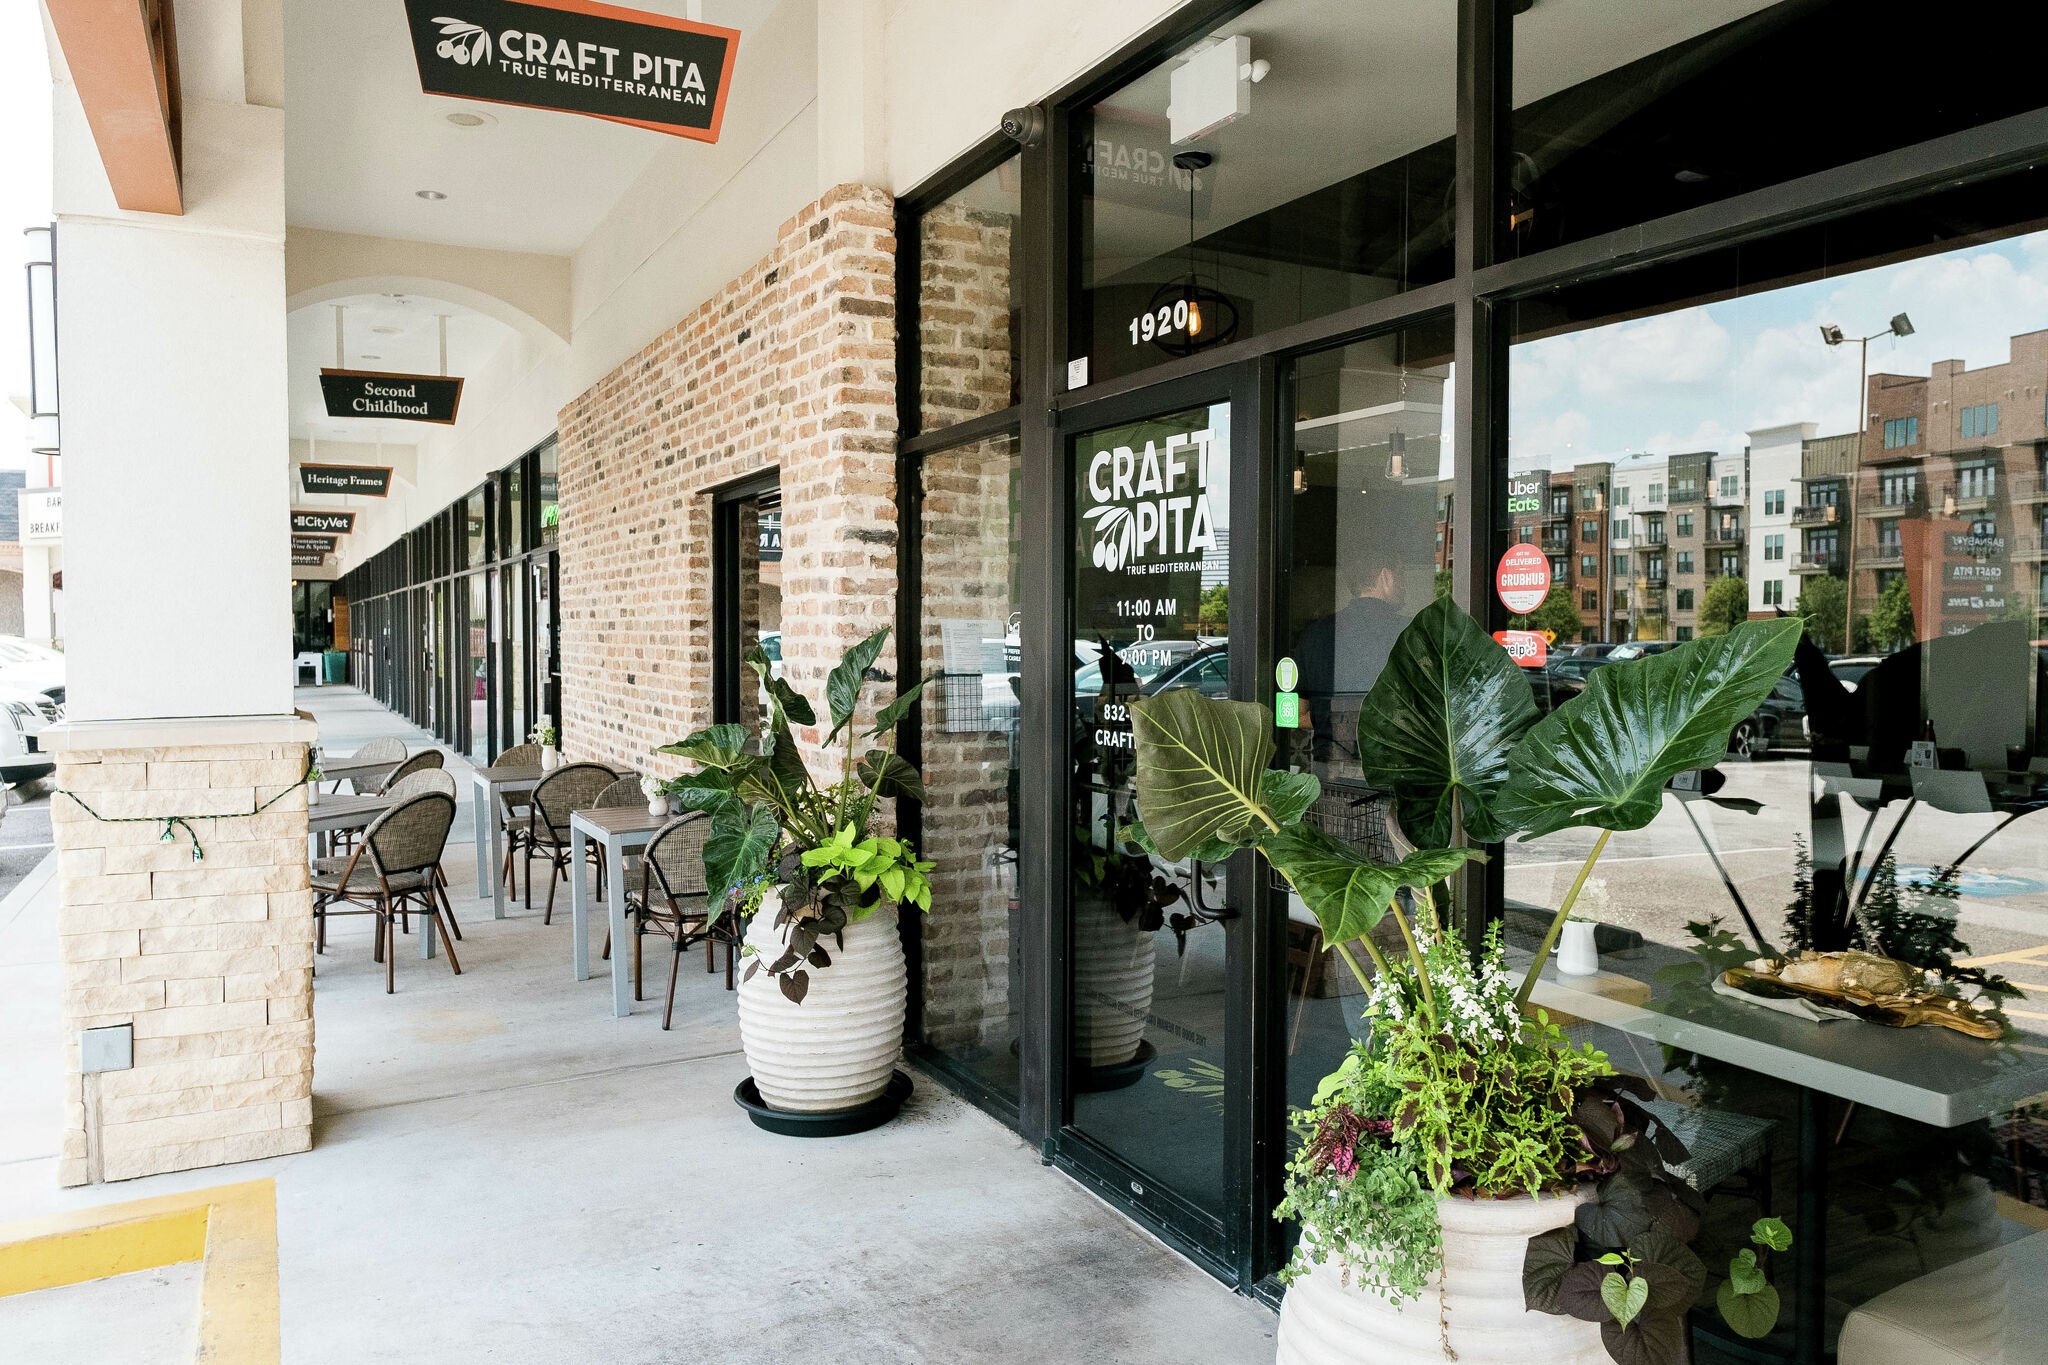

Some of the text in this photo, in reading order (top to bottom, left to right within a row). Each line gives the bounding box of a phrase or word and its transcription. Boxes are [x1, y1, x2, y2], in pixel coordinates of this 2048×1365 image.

[499, 29, 705, 92] CRAFT PITA
[500, 59, 706, 106] TRUE MEDITERRANEAN
[1129, 299, 1189, 345] 1920
[364, 382, 416, 398] Second
[352, 398, 428, 415] Childhood
[1088, 428, 1216, 503] CRAFT
[307, 474, 383, 487] Heritage Frames
[1508, 481, 1541, 496] Uber
[1508, 497, 1540, 512] Eats
[305, 516, 348, 530] CityVet
[1136, 494, 1218, 557] PITA
[1126, 560, 1219, 576] TRUE MEDITERRANEAN
[1505, 557, 1542, 566] DELIVERED
[1501, 572, 1545, 586] GRUBHUB
[1116, 599, 1177, 616] 11:00 AM
[1136, 624, 1155, 641] TO
[1121, 649, 1172, 666] 9:00 PM
[1103, 703, 1132, 722] 832-
[1095, 729, 1137, 749] CRAFT
